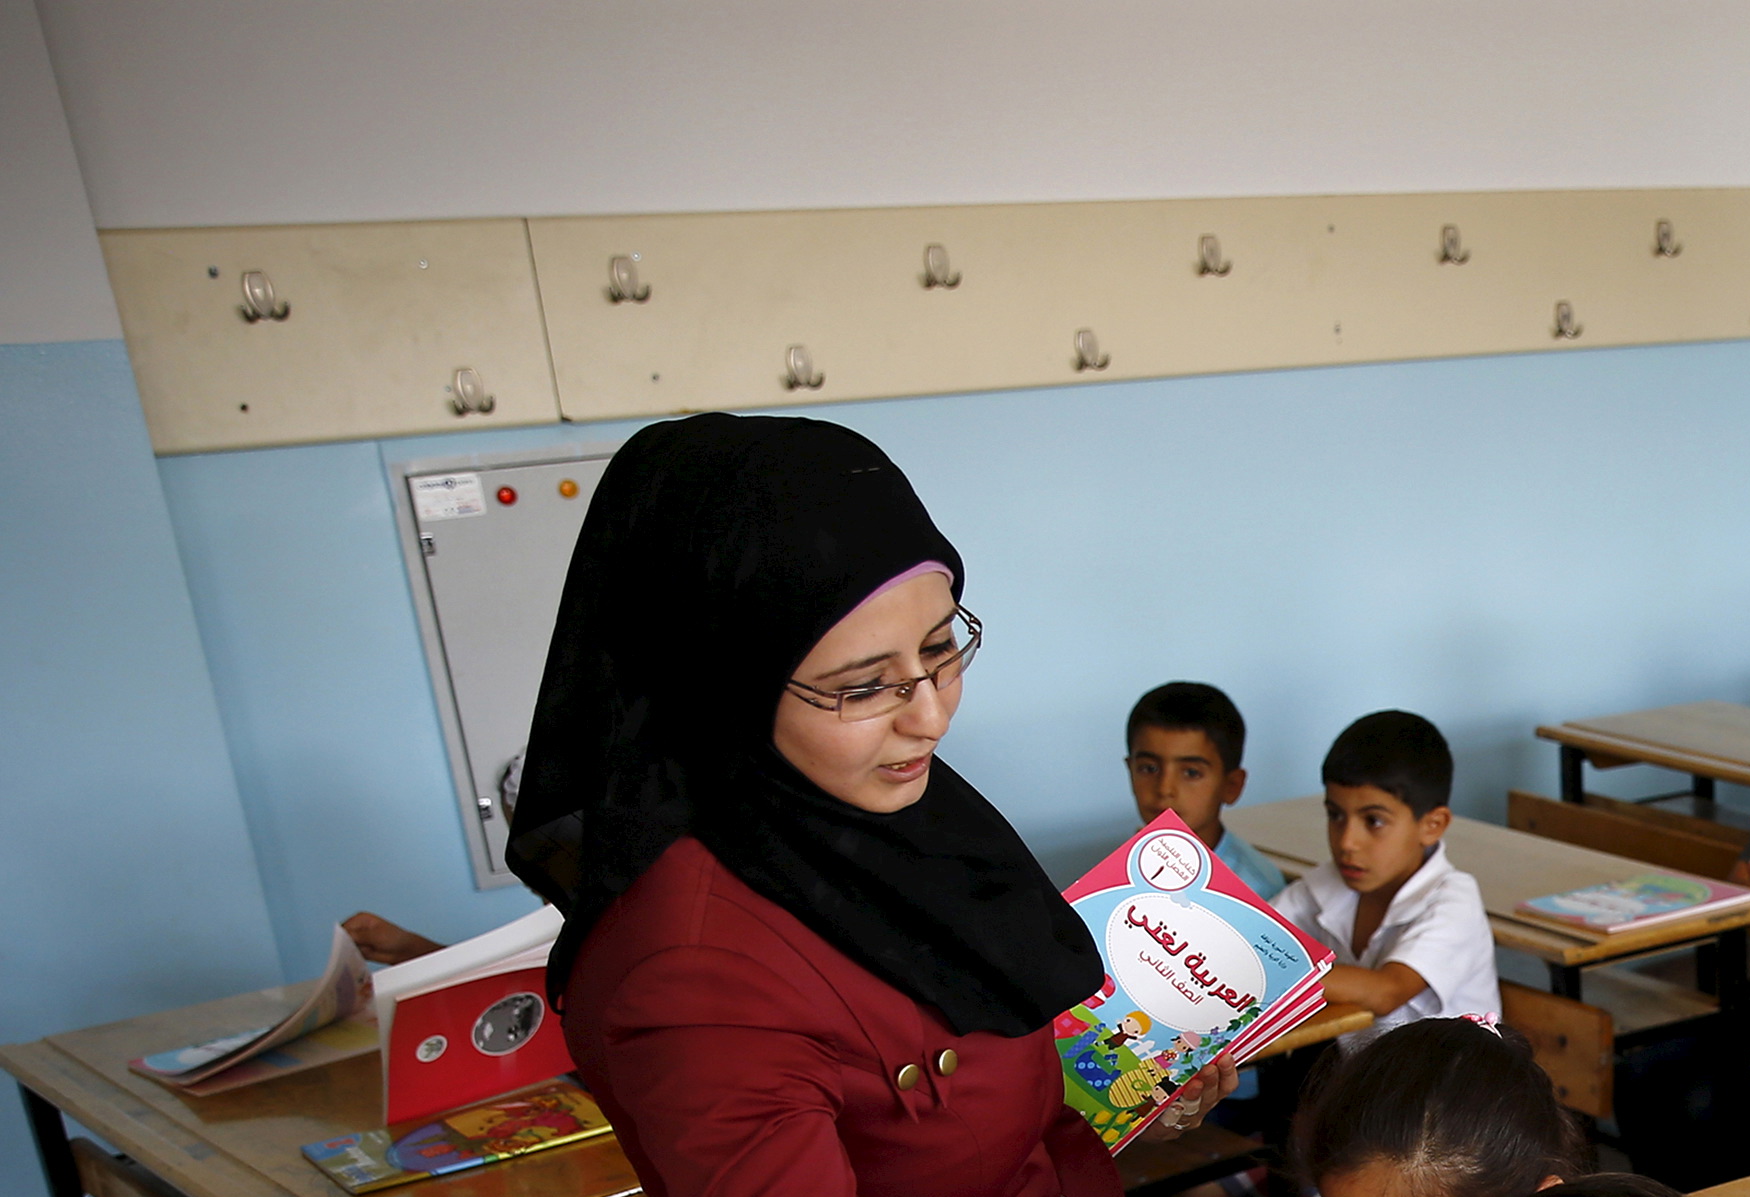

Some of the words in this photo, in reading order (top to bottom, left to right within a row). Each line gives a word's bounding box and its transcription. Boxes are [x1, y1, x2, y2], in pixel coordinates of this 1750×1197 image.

[1179, 858, 1196, 876] كتاب
[1124, 905, 1189, 956] لغتي
[1137, 950, 1176, 980] الثاني
[1171, 977, 1205, 1006] الصف
[1184, 952, 1257, 1013] العربية
